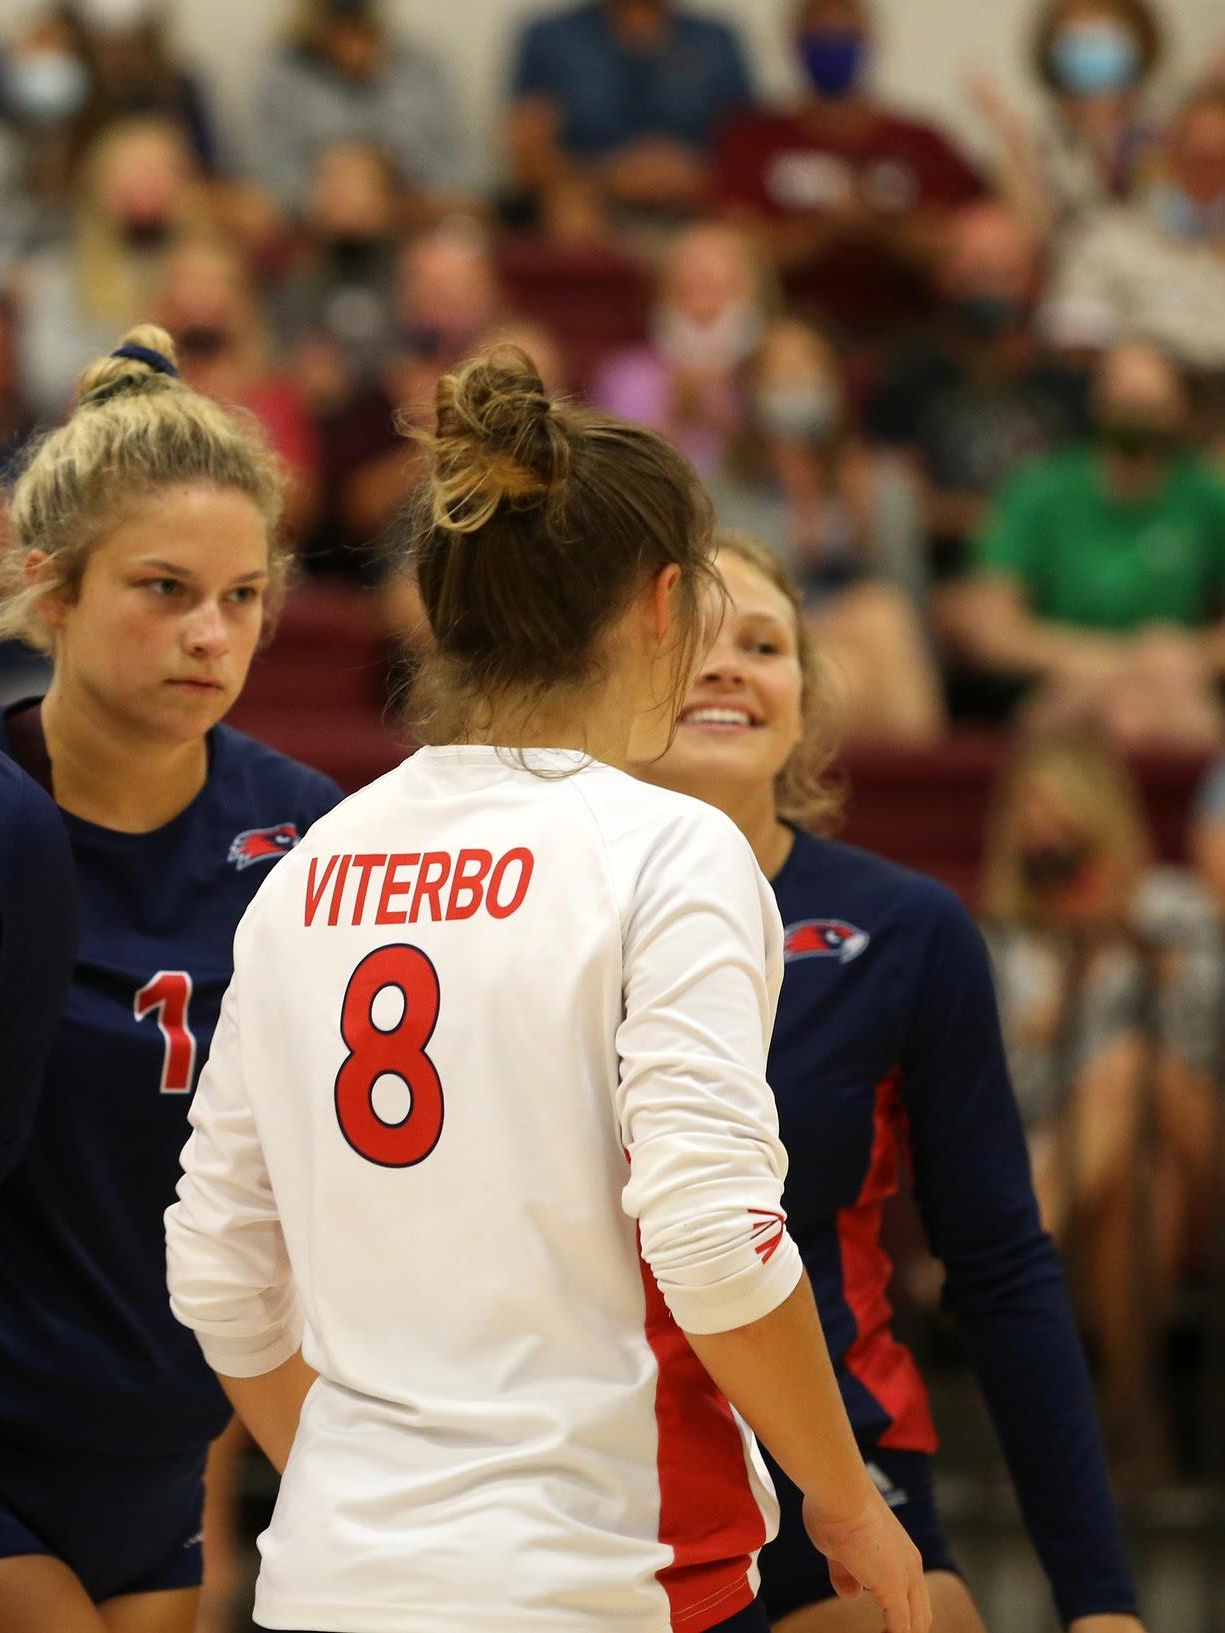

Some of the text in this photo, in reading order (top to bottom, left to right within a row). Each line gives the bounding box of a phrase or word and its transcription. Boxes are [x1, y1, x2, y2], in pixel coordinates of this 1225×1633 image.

[304, 847, 535, 927] VITERBO
[134, 970, 196, 1094] 1
[333, 942, 445, 1169] 8
